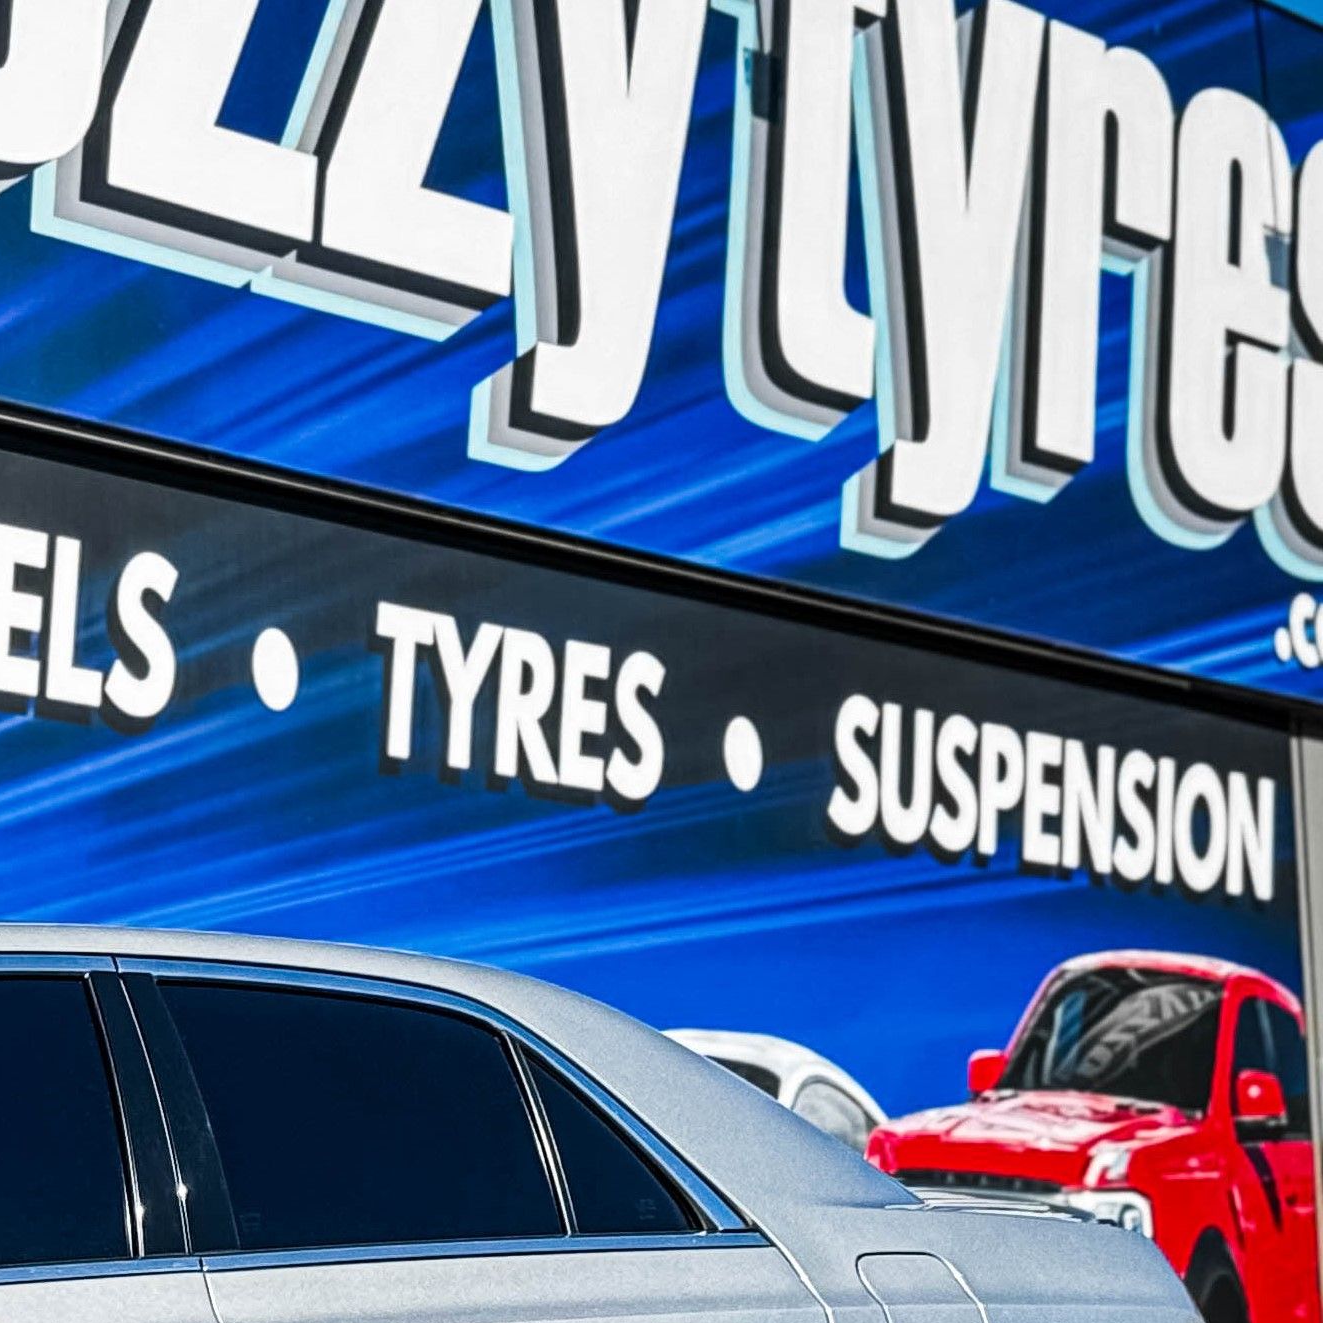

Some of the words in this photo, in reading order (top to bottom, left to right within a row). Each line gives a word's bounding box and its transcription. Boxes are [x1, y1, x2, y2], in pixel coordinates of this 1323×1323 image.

[1274, 592, 1323, 669] .c
[376, 601, 666, 800] TYRES
[827, 694, 1274, 900] SUSPENSION
